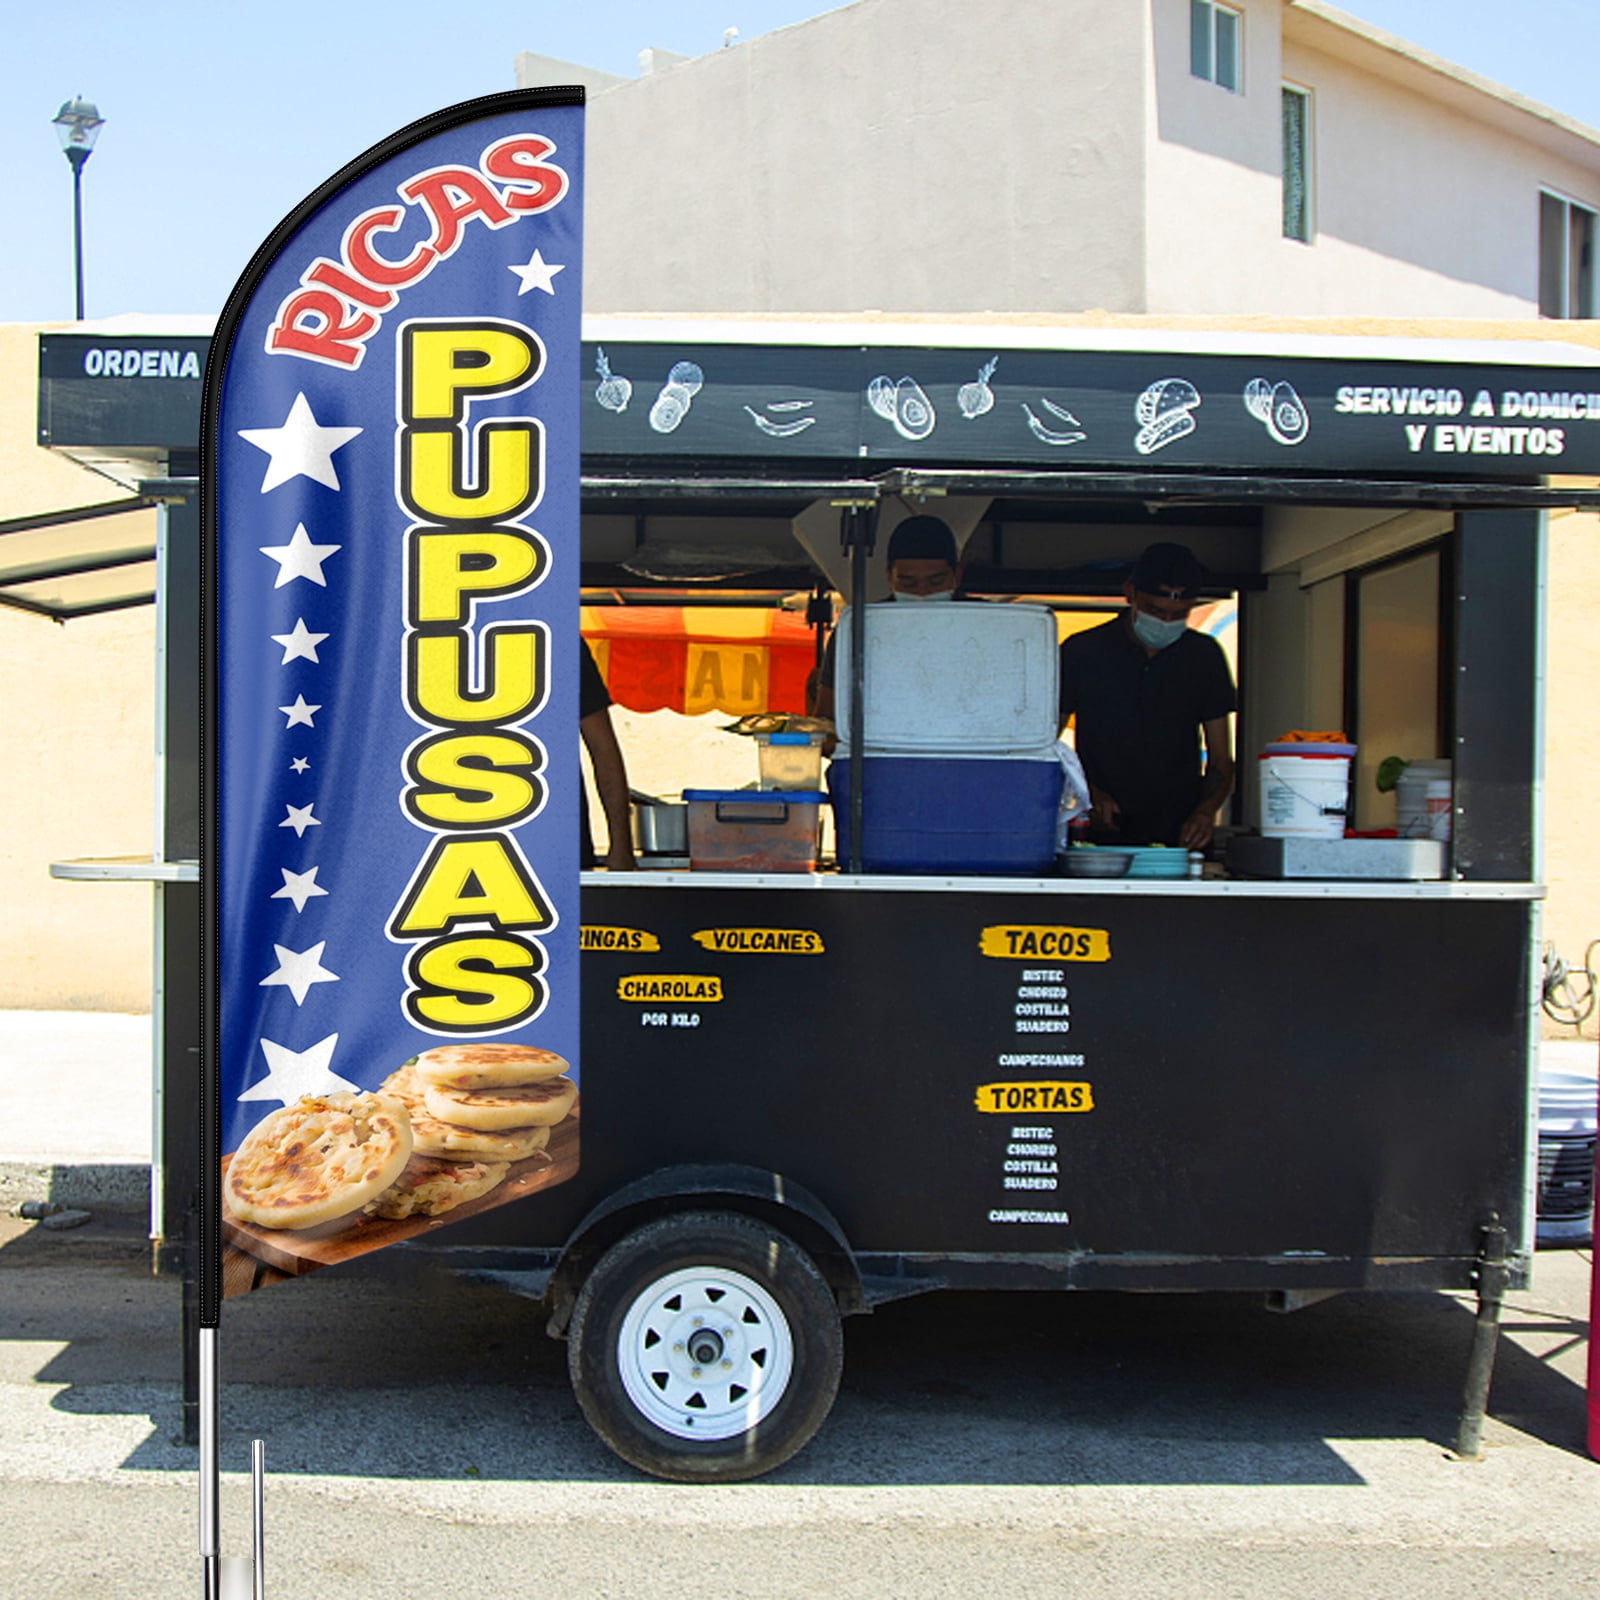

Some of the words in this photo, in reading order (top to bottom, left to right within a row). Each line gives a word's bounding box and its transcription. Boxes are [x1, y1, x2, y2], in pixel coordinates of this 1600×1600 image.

[268, 134, 568, 370] RICAS
[84, 348, 201, 378] ORDENA
[1334, 386, 1464, 416] SERVICIO
[1470, 390, 1495, 417] A
[1405, 424, 1428, 452] Y
[1433, 425, 1565, 455] EVENTOS
[390, 321, 554, 1034] PUPUSAS
[580, 929, 643, 949] INGAS
[713, 931, 816, 951] VOLCANES
[1006, 930, 1091, 957] TACOS
[1022, 970, 1064, 982] BISTEC
[623, 981, 718, 998] CHAROLAS
[1017, 986, 1068, 999] CHORIZO
[1015, 1003, 1070, 1016] COSTILLA
[641, 1013, 668, 1026] POR
[671, 1013, 701, 1027] KILO
[1015, 1020, 1070, 1033] SUADERO
[998, 1054, 1085, 1067] CAMPECHANOS
[991, 1087, 1083, 1109] TORTAS
[1011, 1126, 1054, 1139] BISTEC
[1006, 1143, 1057, 1157] CHORIZO
[1003, 1160, 1059, 1173] COSTILLA
[1003, 1177, 1058, 1190] SUADERO
[988, 1209, 1070, 1223] CAMPECHANA
